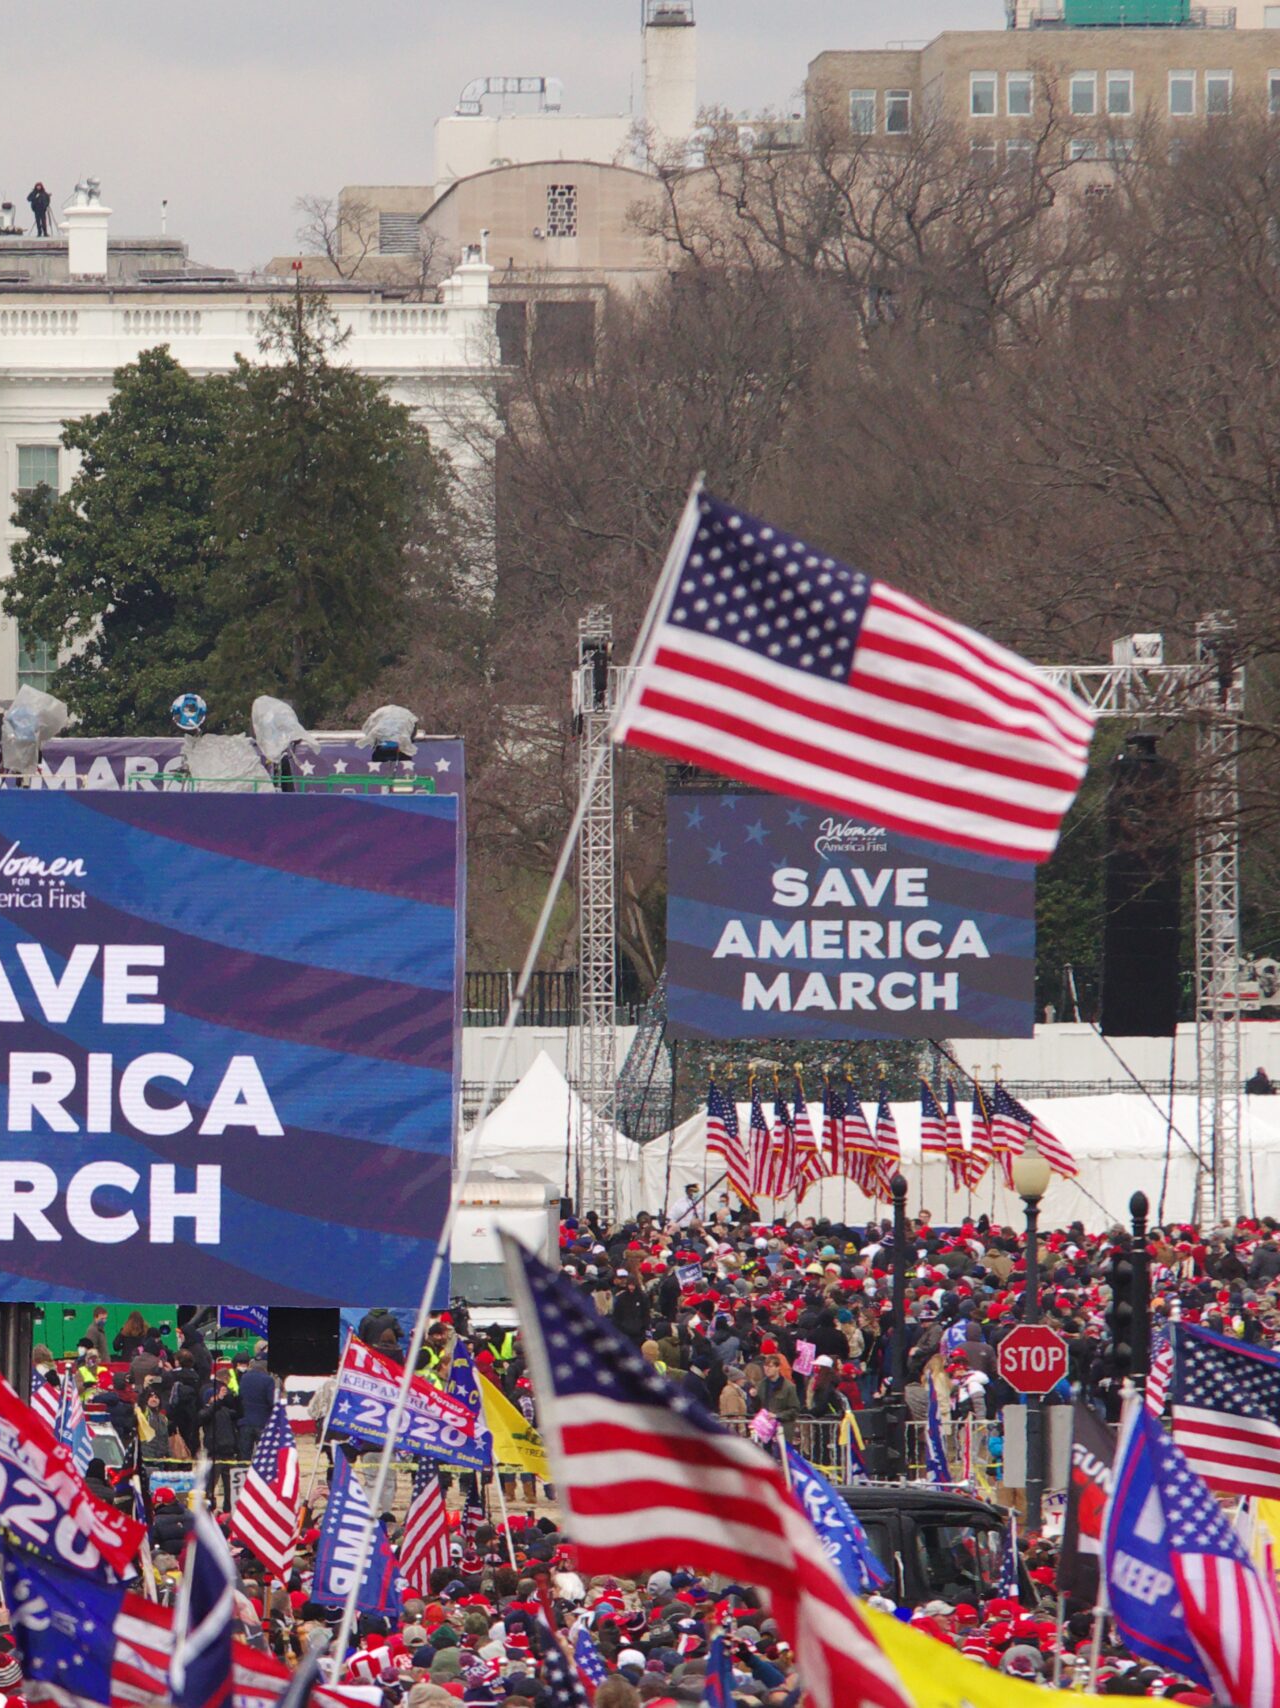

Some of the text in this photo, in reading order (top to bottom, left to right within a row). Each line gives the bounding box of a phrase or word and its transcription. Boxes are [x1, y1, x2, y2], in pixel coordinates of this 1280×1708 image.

[819, 817, 887, 837] Women
[822, 841, 888, 852] America First
[11, 877, 31, 887] FOR
[773, 867, 928, 907] SAVE
[48, 888, 87, 909] First
[712, 919, 990, 960] AMERICA
[742, 971, 959, 1012] MARCH
[1004, 1346, 1063, 1373] STOP
[343, 1372, 378, 1394] KEEP
[354, 1398, 468, 1447] 2020
[1111, 1549, 1175, 1607] KEEP
